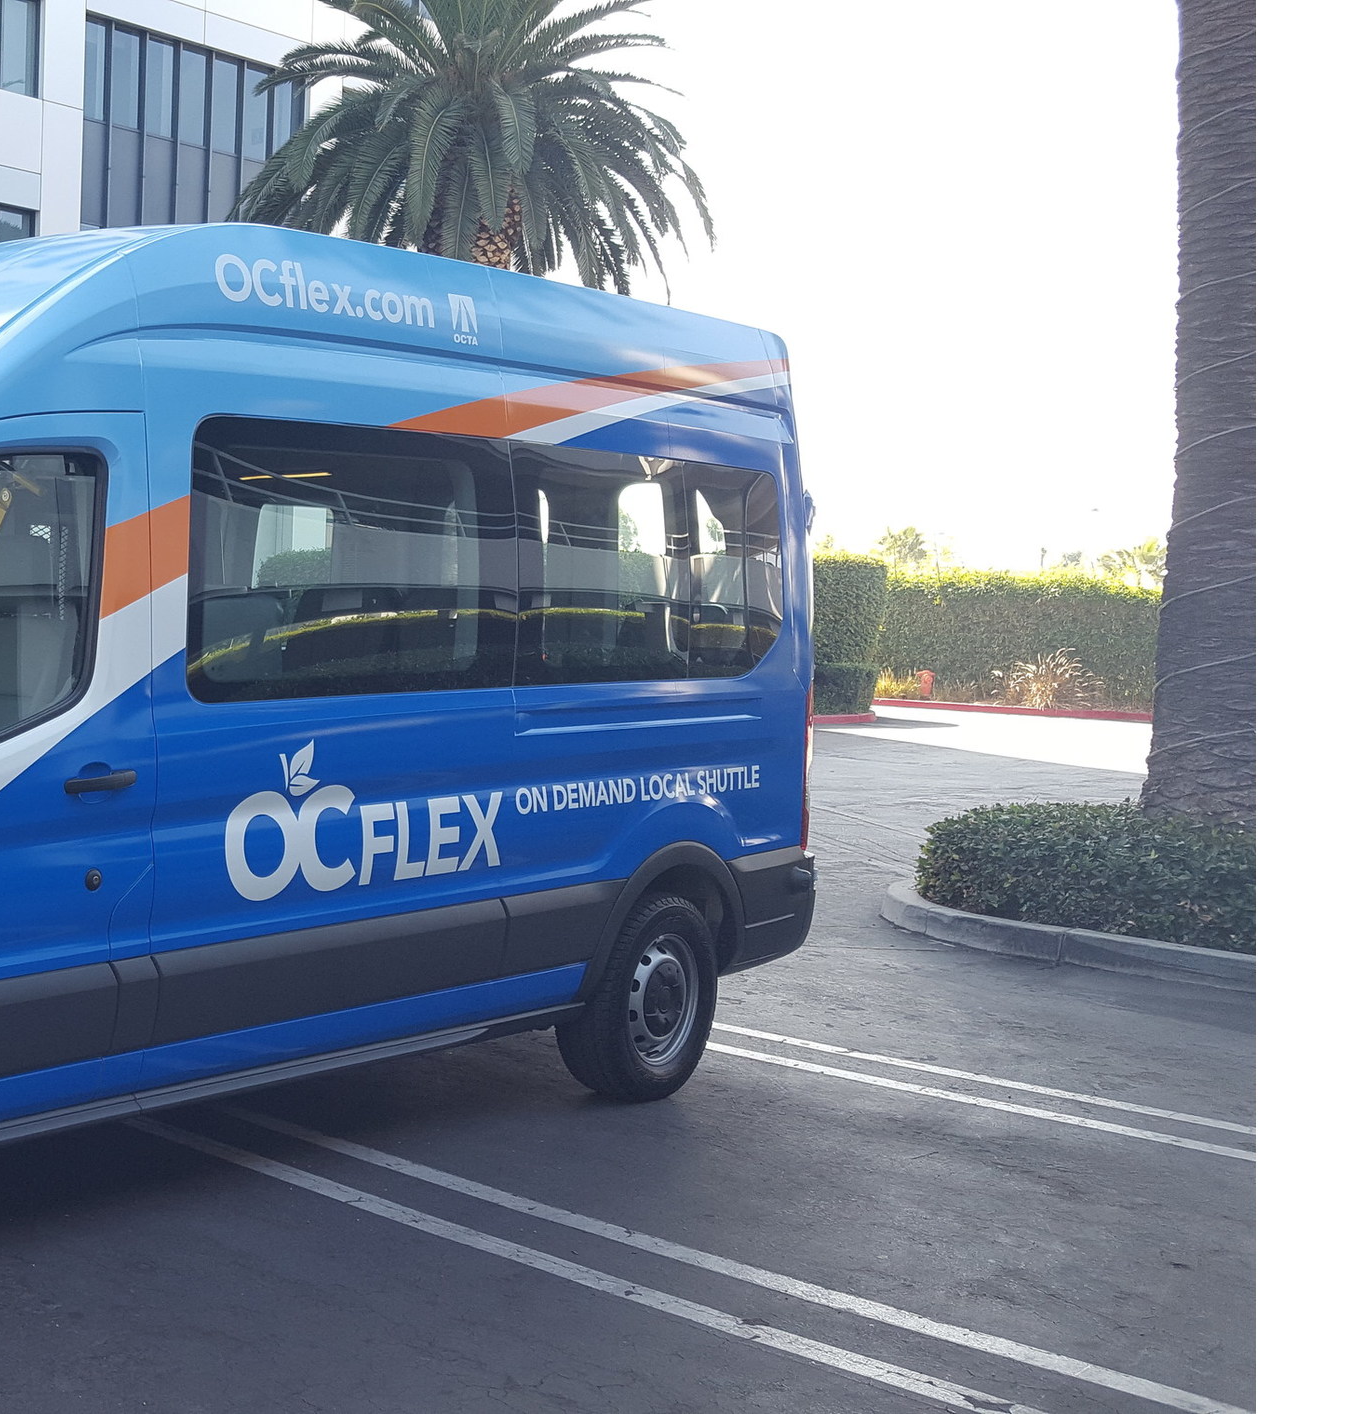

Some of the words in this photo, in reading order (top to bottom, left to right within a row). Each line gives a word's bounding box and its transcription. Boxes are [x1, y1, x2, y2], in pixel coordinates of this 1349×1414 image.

[214, 253, 435, 328] OCflex.com
[453, 334, 478, 346] OCTA
[515, 785, 548, 815] ON
[552, 778, 636, 811] DEMAND
[640, 772, 696, 801] LOCAL
[697, 765, 760, 796] SHUTTLE
